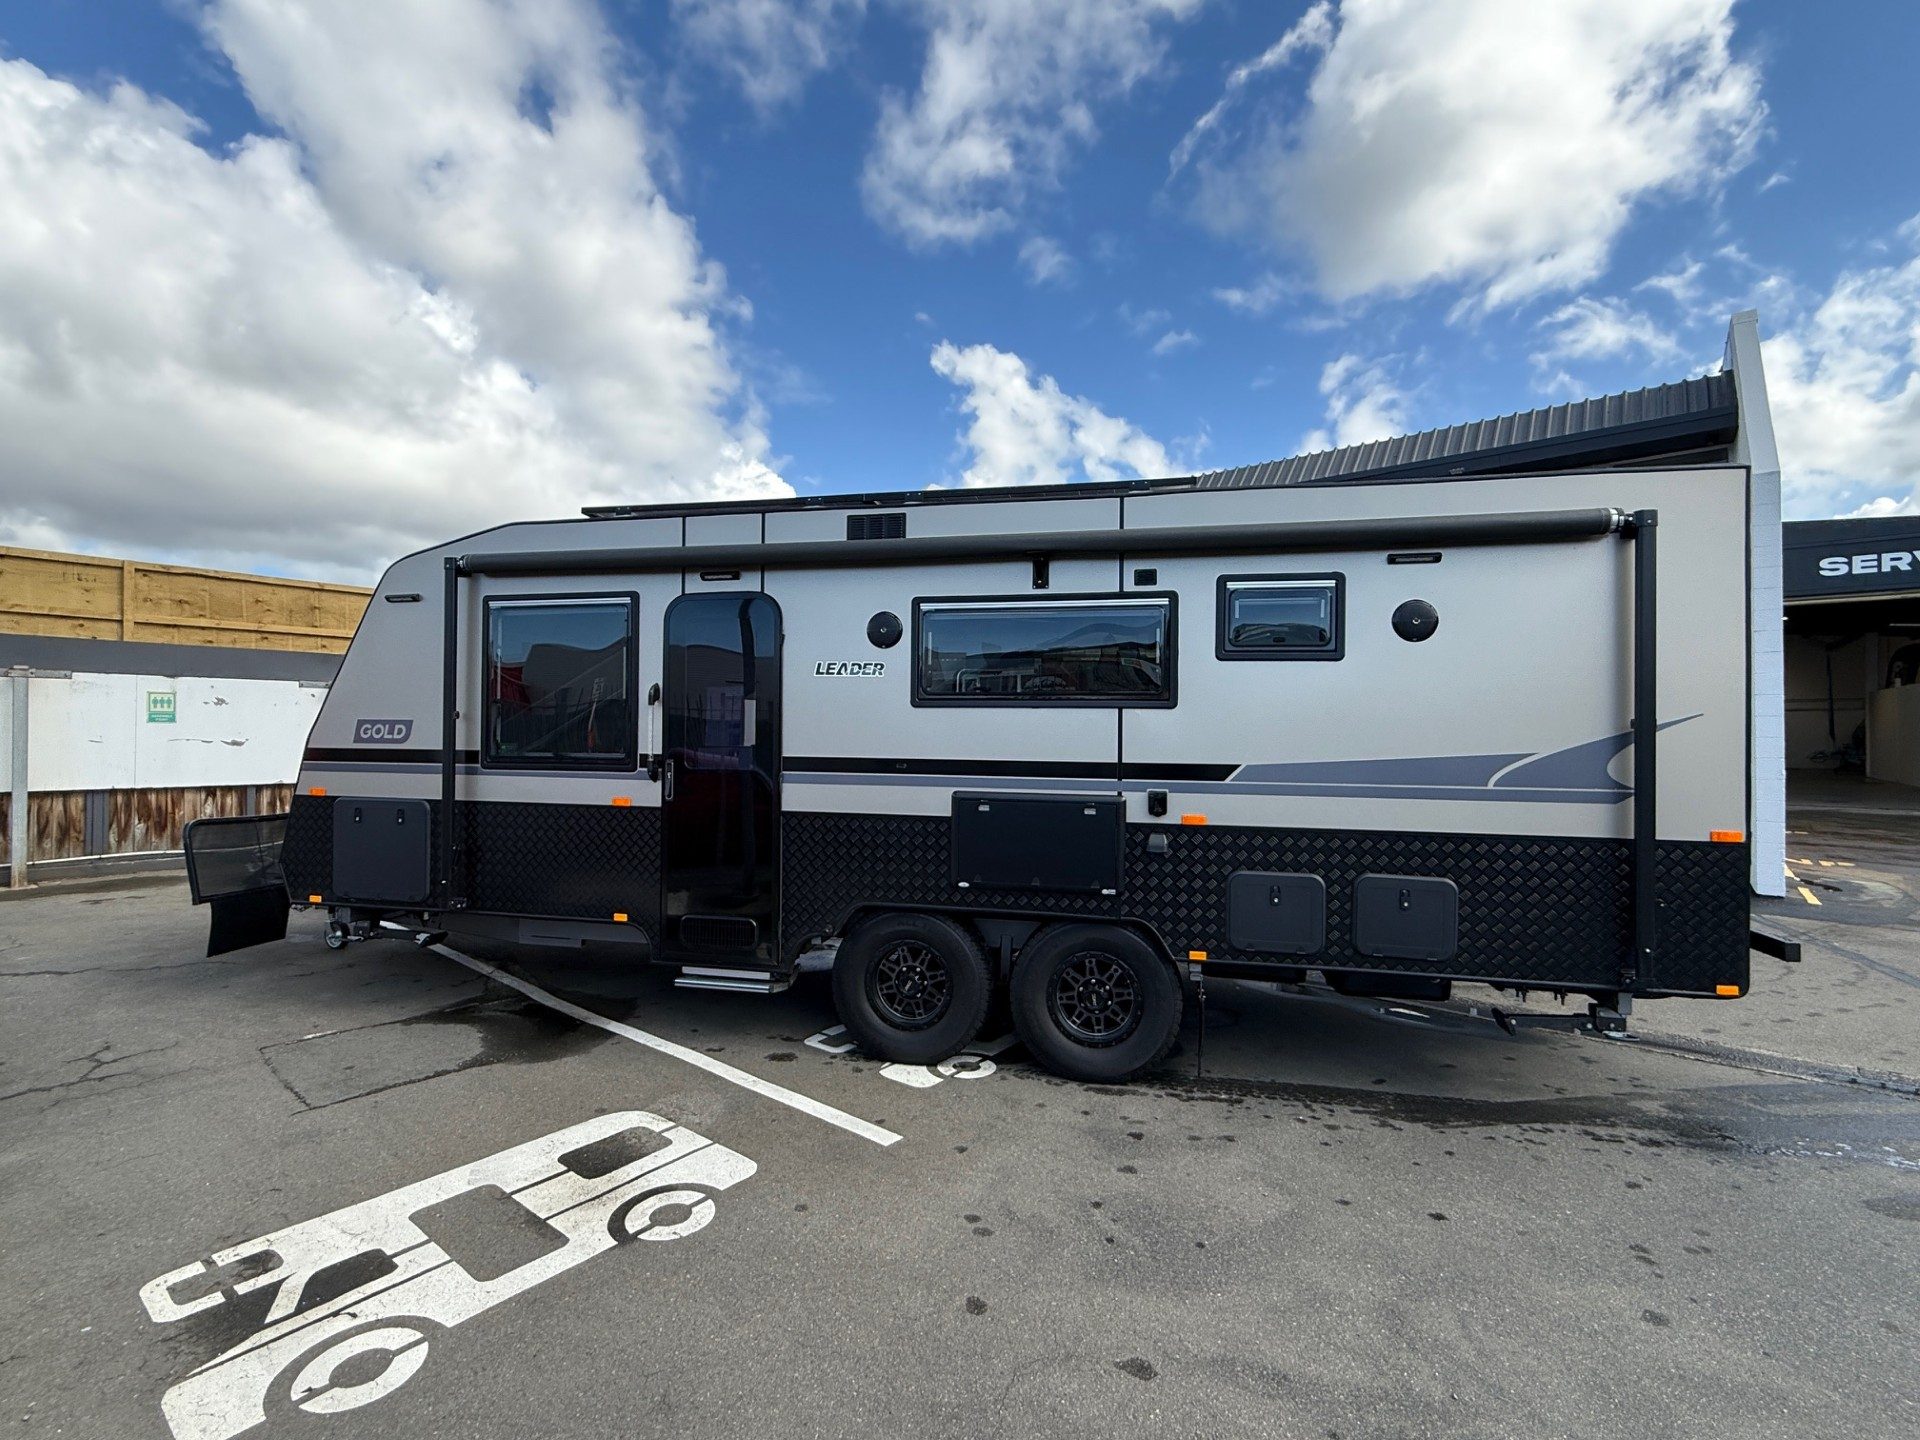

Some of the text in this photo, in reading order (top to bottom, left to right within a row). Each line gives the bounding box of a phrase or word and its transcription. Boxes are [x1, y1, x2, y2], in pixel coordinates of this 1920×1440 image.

[1819, 550, 1920, 577] SER
[814, 661, 885, 677] LEADER
[360, 724, 406, 739] GOLD
